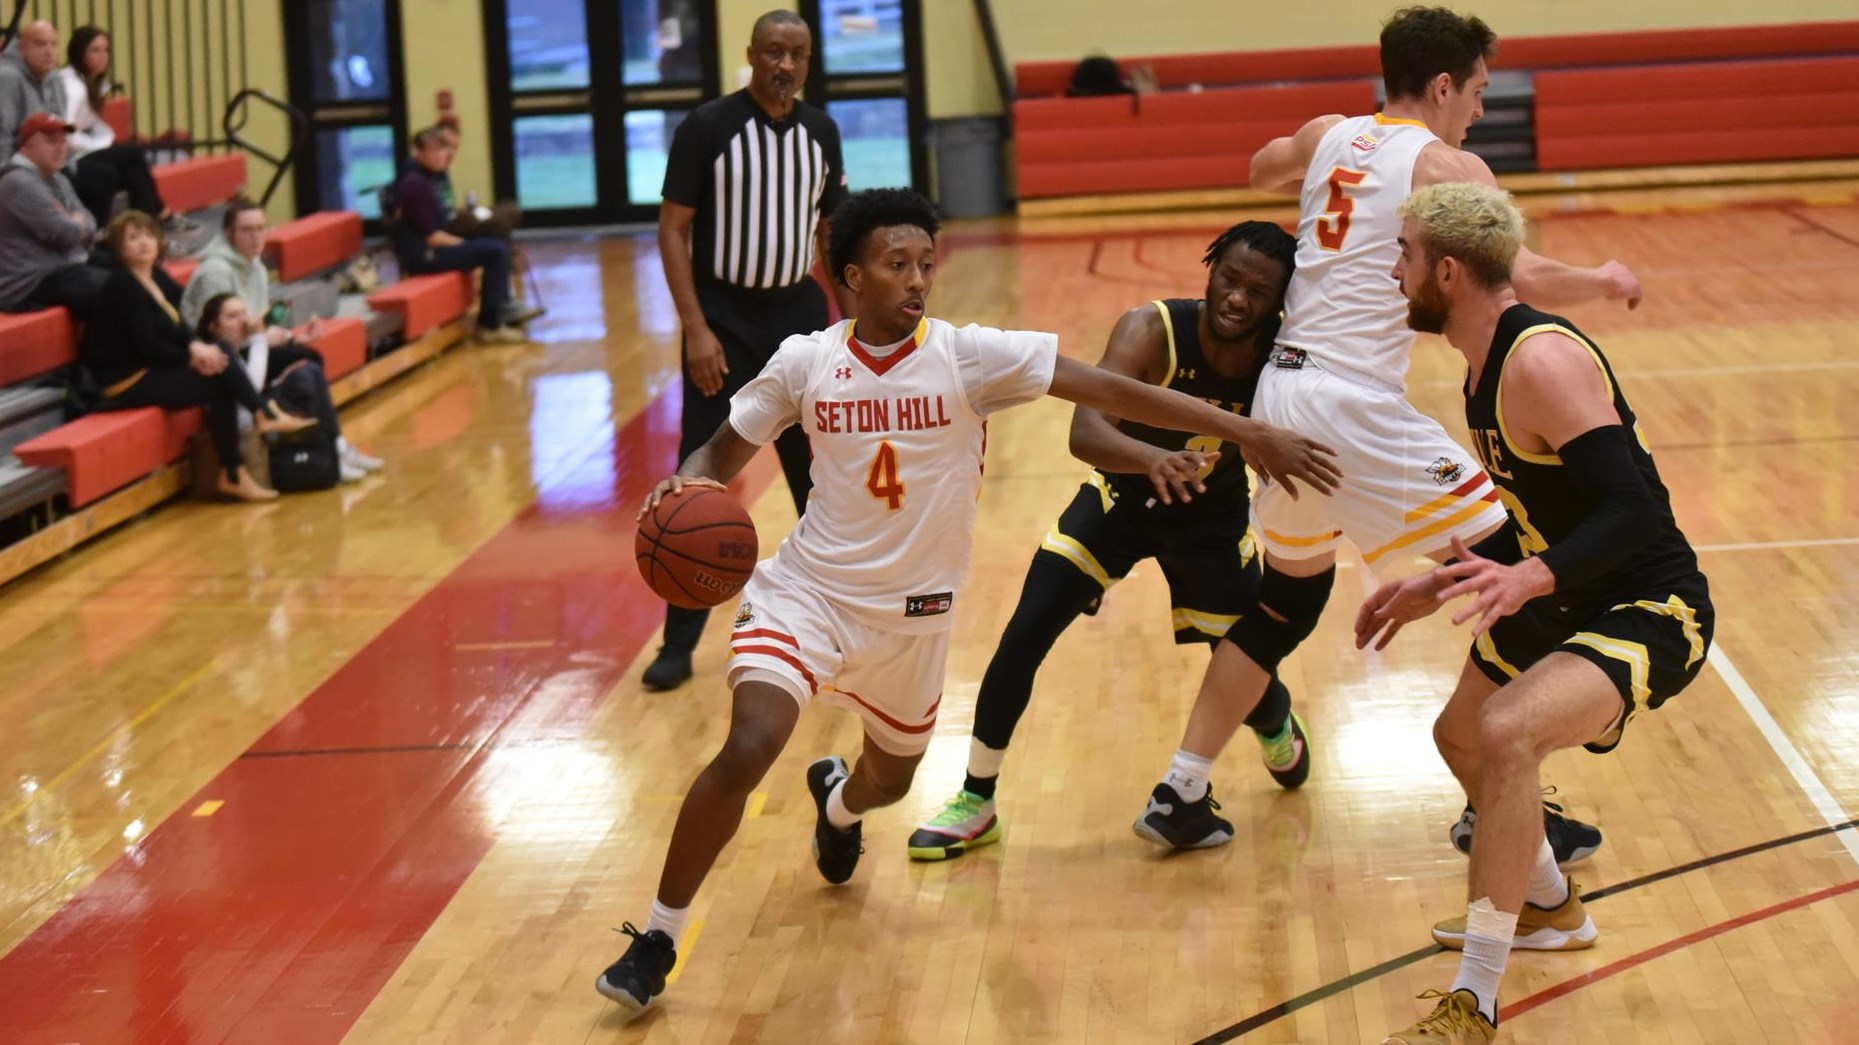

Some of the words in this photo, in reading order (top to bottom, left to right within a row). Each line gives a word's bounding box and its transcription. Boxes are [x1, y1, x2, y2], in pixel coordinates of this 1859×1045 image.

[1315, 165, 1369, 254] 5
[815, 399, 889, 433] SETON
[897, 395, 951, 431] HILL
[864, 438, 906, 511] 4
